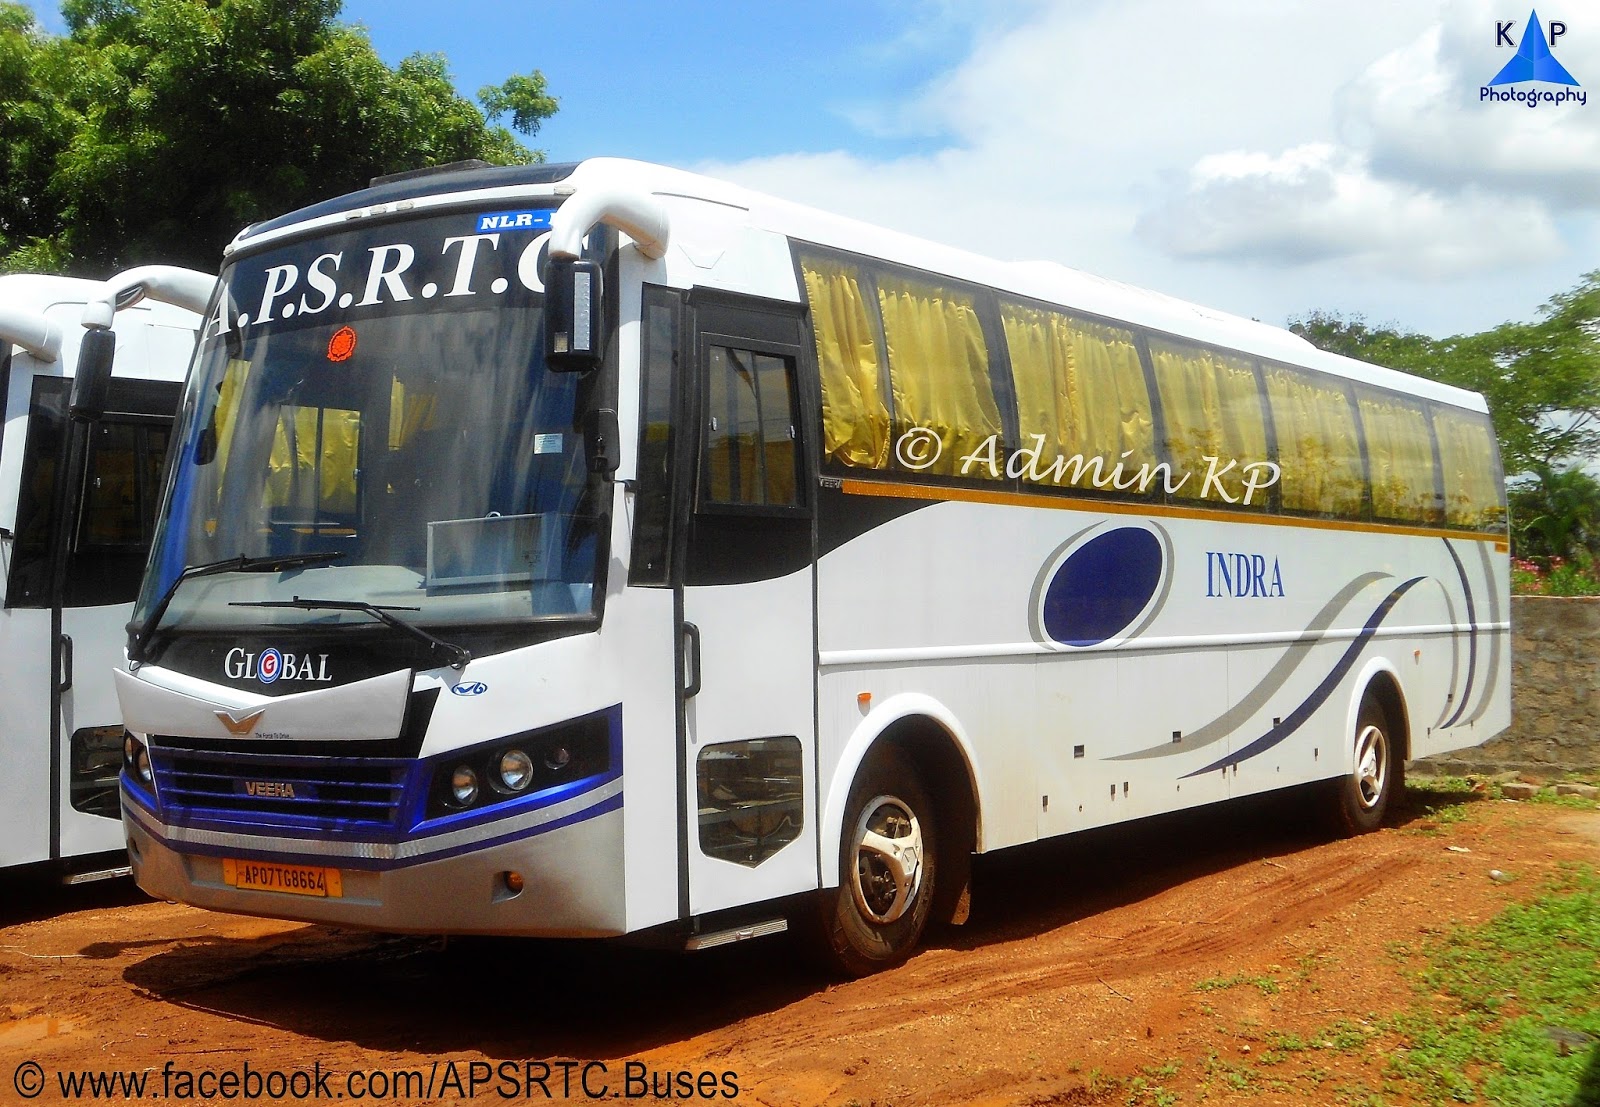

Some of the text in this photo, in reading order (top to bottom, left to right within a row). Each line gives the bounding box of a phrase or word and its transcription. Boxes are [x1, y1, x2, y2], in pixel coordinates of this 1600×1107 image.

[1205, 551, 1286, 598] INDRA
[224, 647, 333, 684] GLOBAL
[245, 781, 295, 798] VEERA
[245, 865, 325, 891] AP07TG8664
